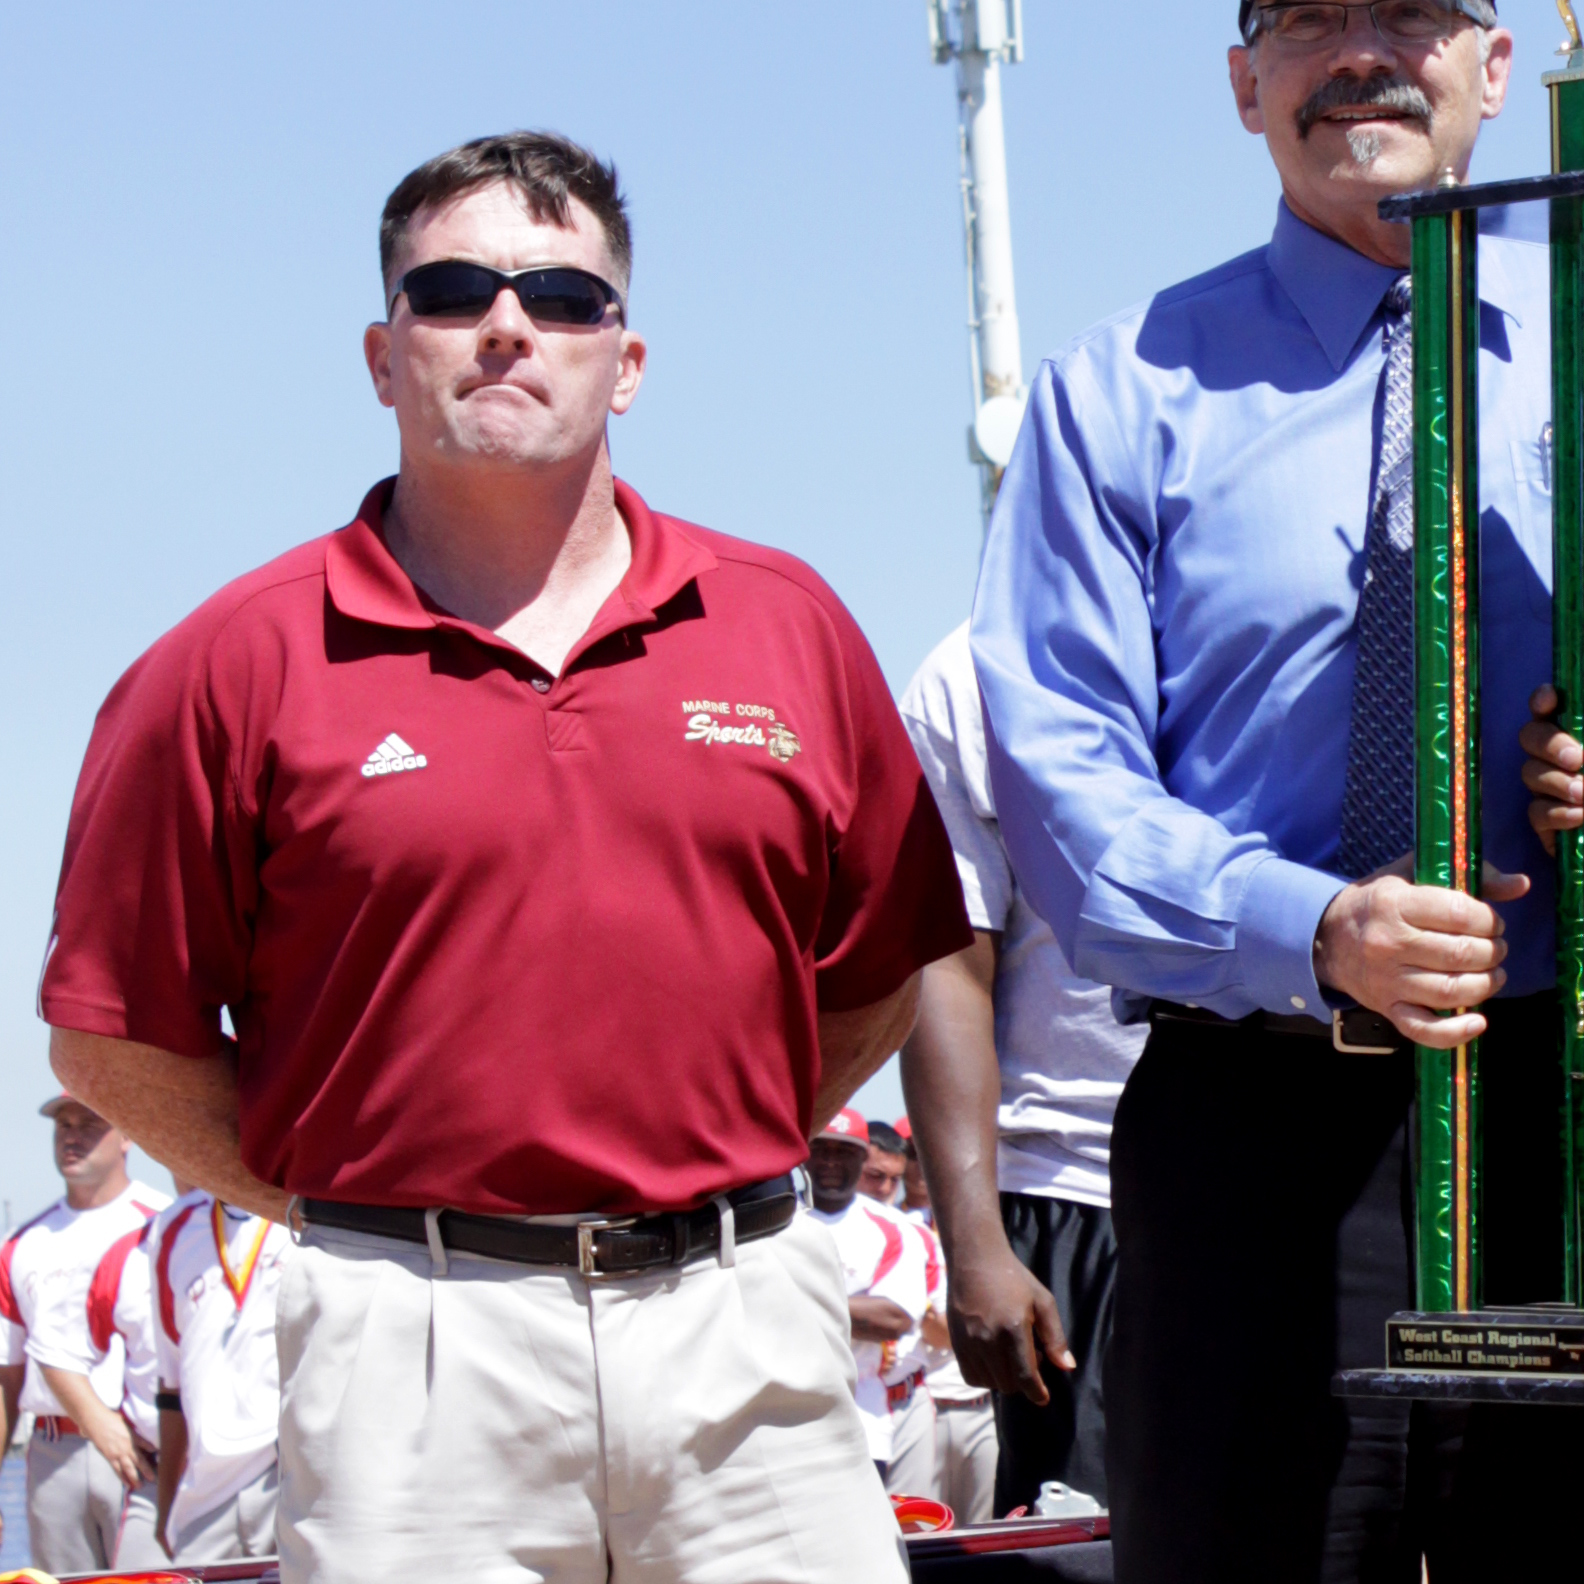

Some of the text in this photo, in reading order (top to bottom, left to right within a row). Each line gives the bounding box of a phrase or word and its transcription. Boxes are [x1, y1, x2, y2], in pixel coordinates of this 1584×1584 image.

[682, 700, 775, 721] MARINE CORPS
[685, 714, 765, 746] Sports
[361, 754, 428, 778] adidas
[1399, 1329, 1556, 1348] West Coast Regional
[1404, 1348, 1462, 1364] Softball
[1467, 1350, 1551, 1368] Champions
